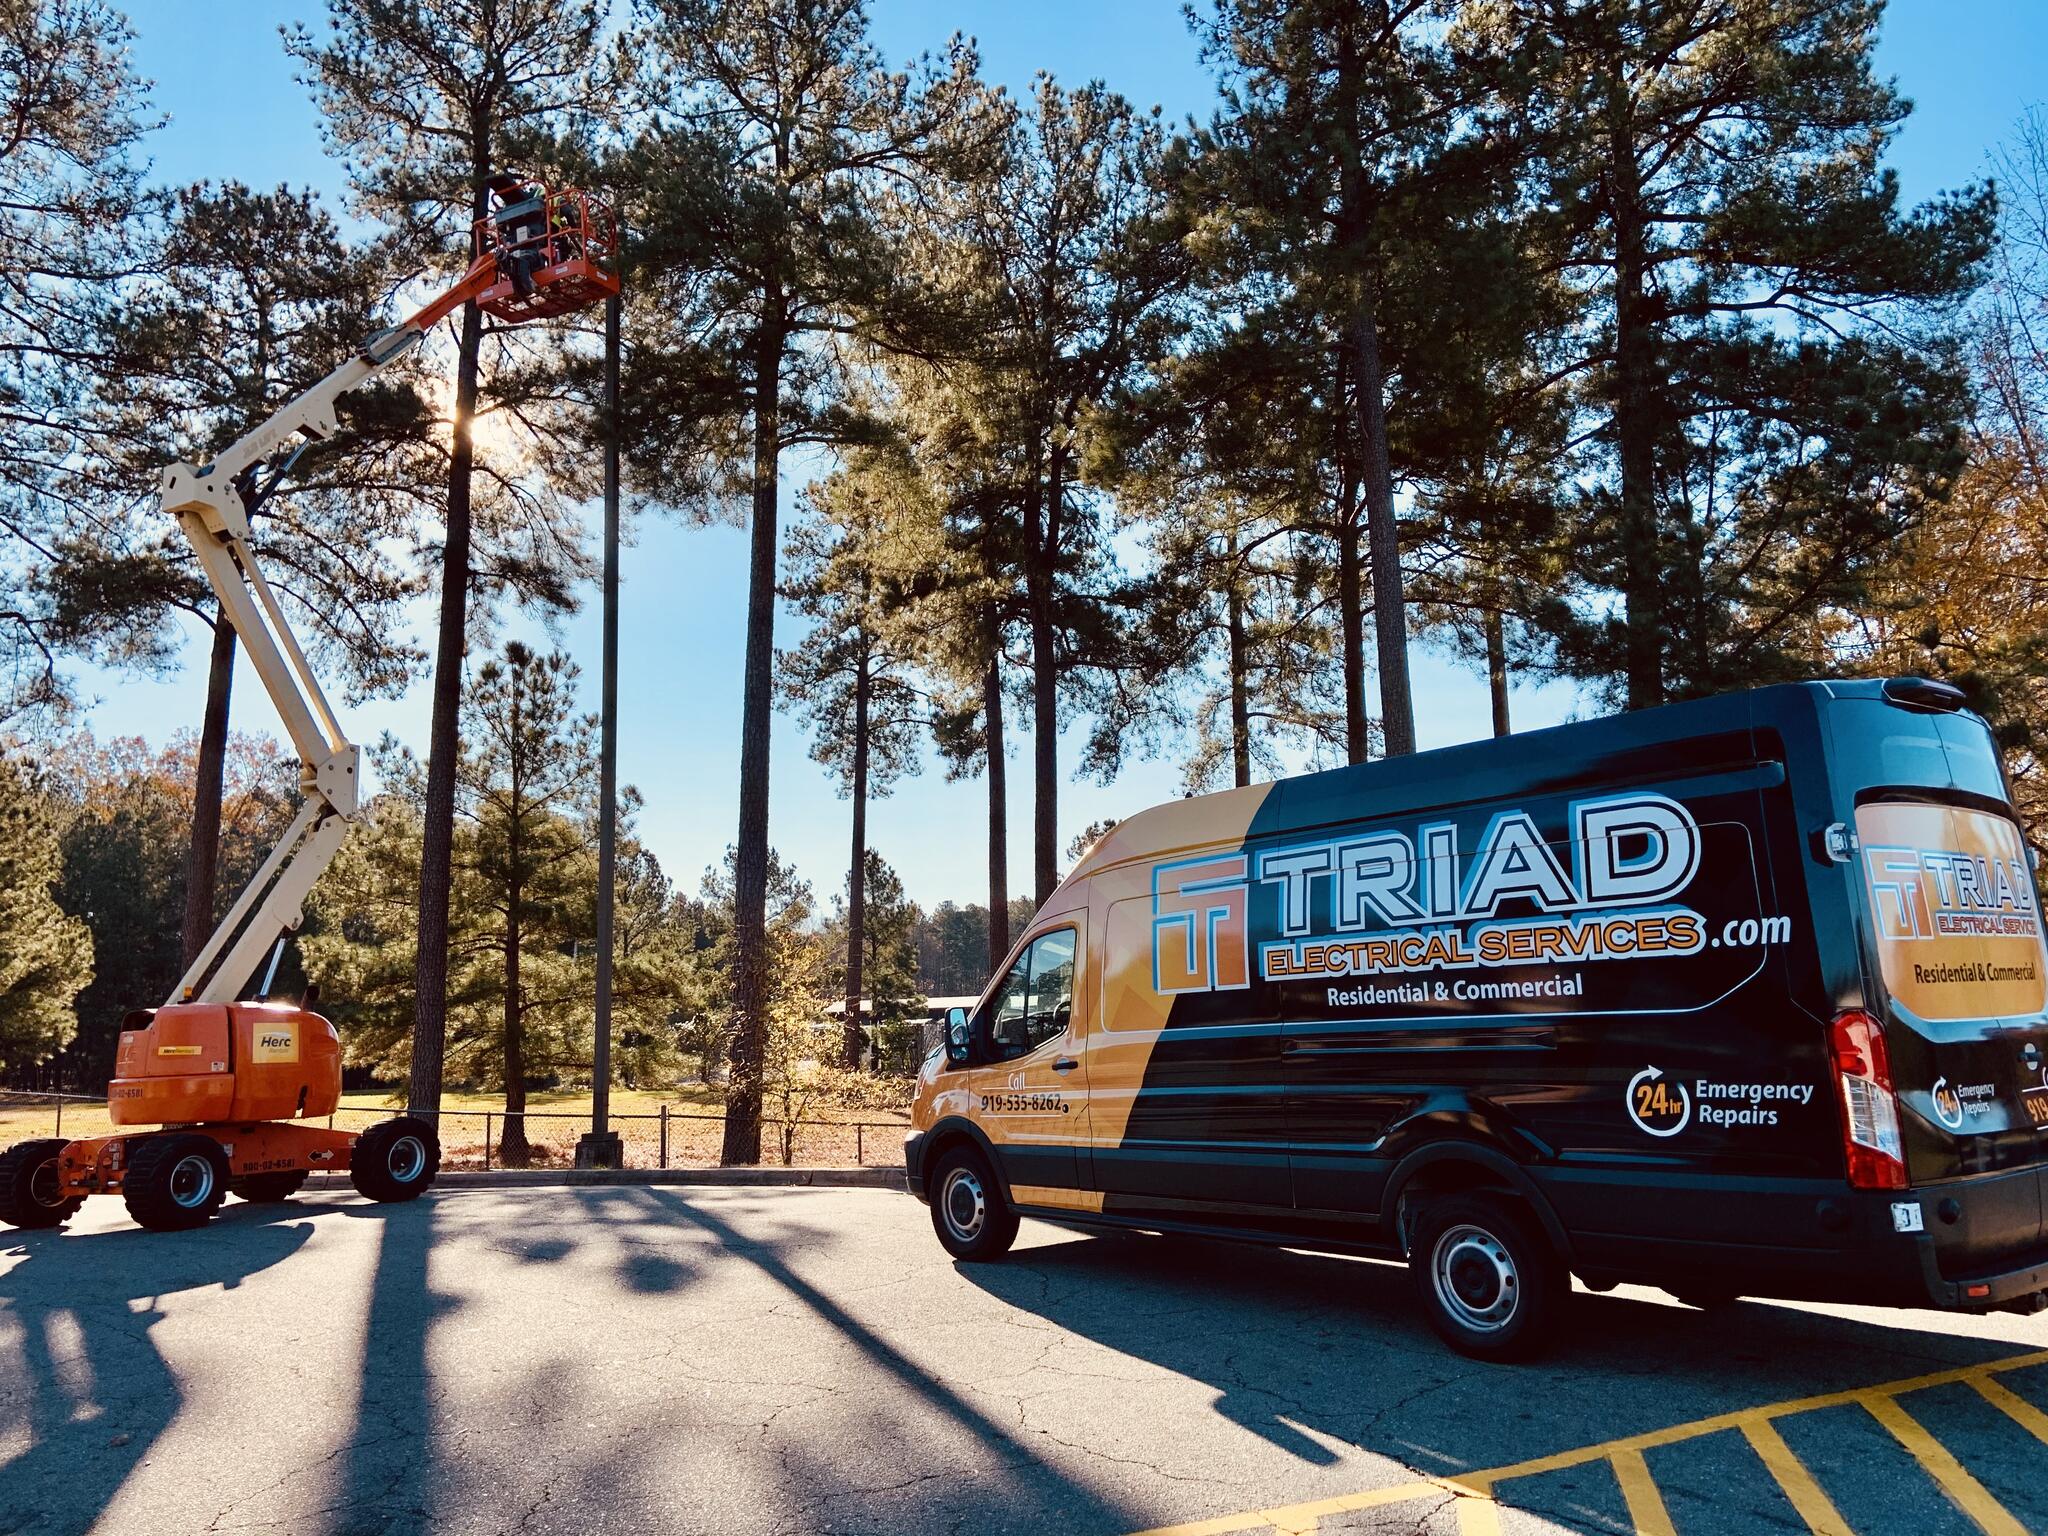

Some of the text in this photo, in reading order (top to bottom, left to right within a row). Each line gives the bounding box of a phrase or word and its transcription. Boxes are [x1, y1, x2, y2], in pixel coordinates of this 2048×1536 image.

[1256, 793, 1701, 937] TRIAD
[1921, 852, 2034, 913] TRIAD
[1937, 915, 2002, 934] ELECTRICAL
[1264, 913, 1791, 979] ELECTRICAL SERVICES .com
[1914, 962, 2036, 983] Residential & Commercial
[1327, 973, 1583, 1006] Residential & Commercial
[260, 1036, 291, 1047] Herc
[1008, 1072, 1025, 1090] Call
[1957, 1083, 1995, 1098] Emergency
[981, 1093, 1061, 1111] 919-535-8262
[1696, 1079, 1814, 1105] Emergency
[1700, 1105, 1778, 1128] Repairs
[1962, 1100, 1990, 1116] Repairs
